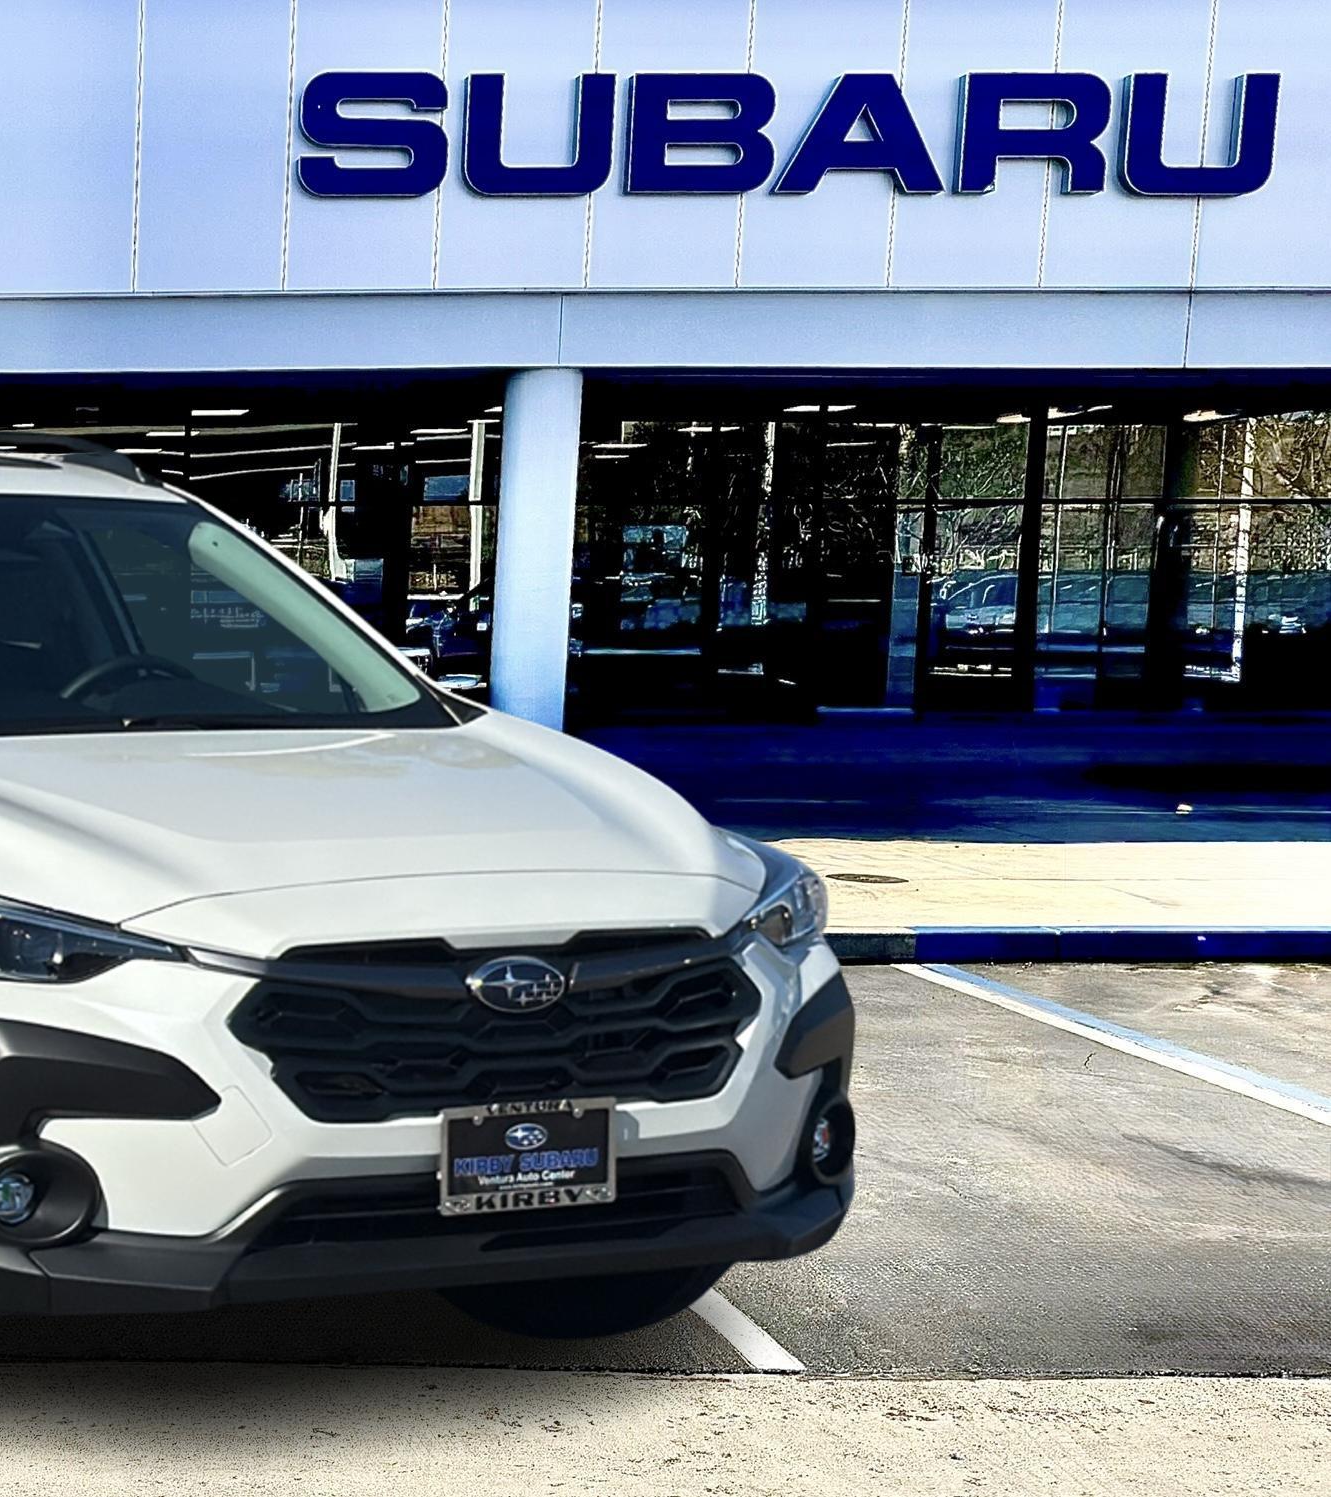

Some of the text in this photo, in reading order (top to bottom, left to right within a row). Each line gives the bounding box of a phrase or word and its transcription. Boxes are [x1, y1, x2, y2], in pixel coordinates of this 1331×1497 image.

[297, 71, 1282, 197] SUBARU
[486, 1100, 573, 1116] VENTURA
[454, 1148, 599, 1177] KIRBY SUBARU
[477, 1174, 515, 1187] Ventura
[516, 1171, 540, 1182] Auto
[541, 1169, 575, 1181] Center
[475, 1189, 585, 1210] KIRBY
